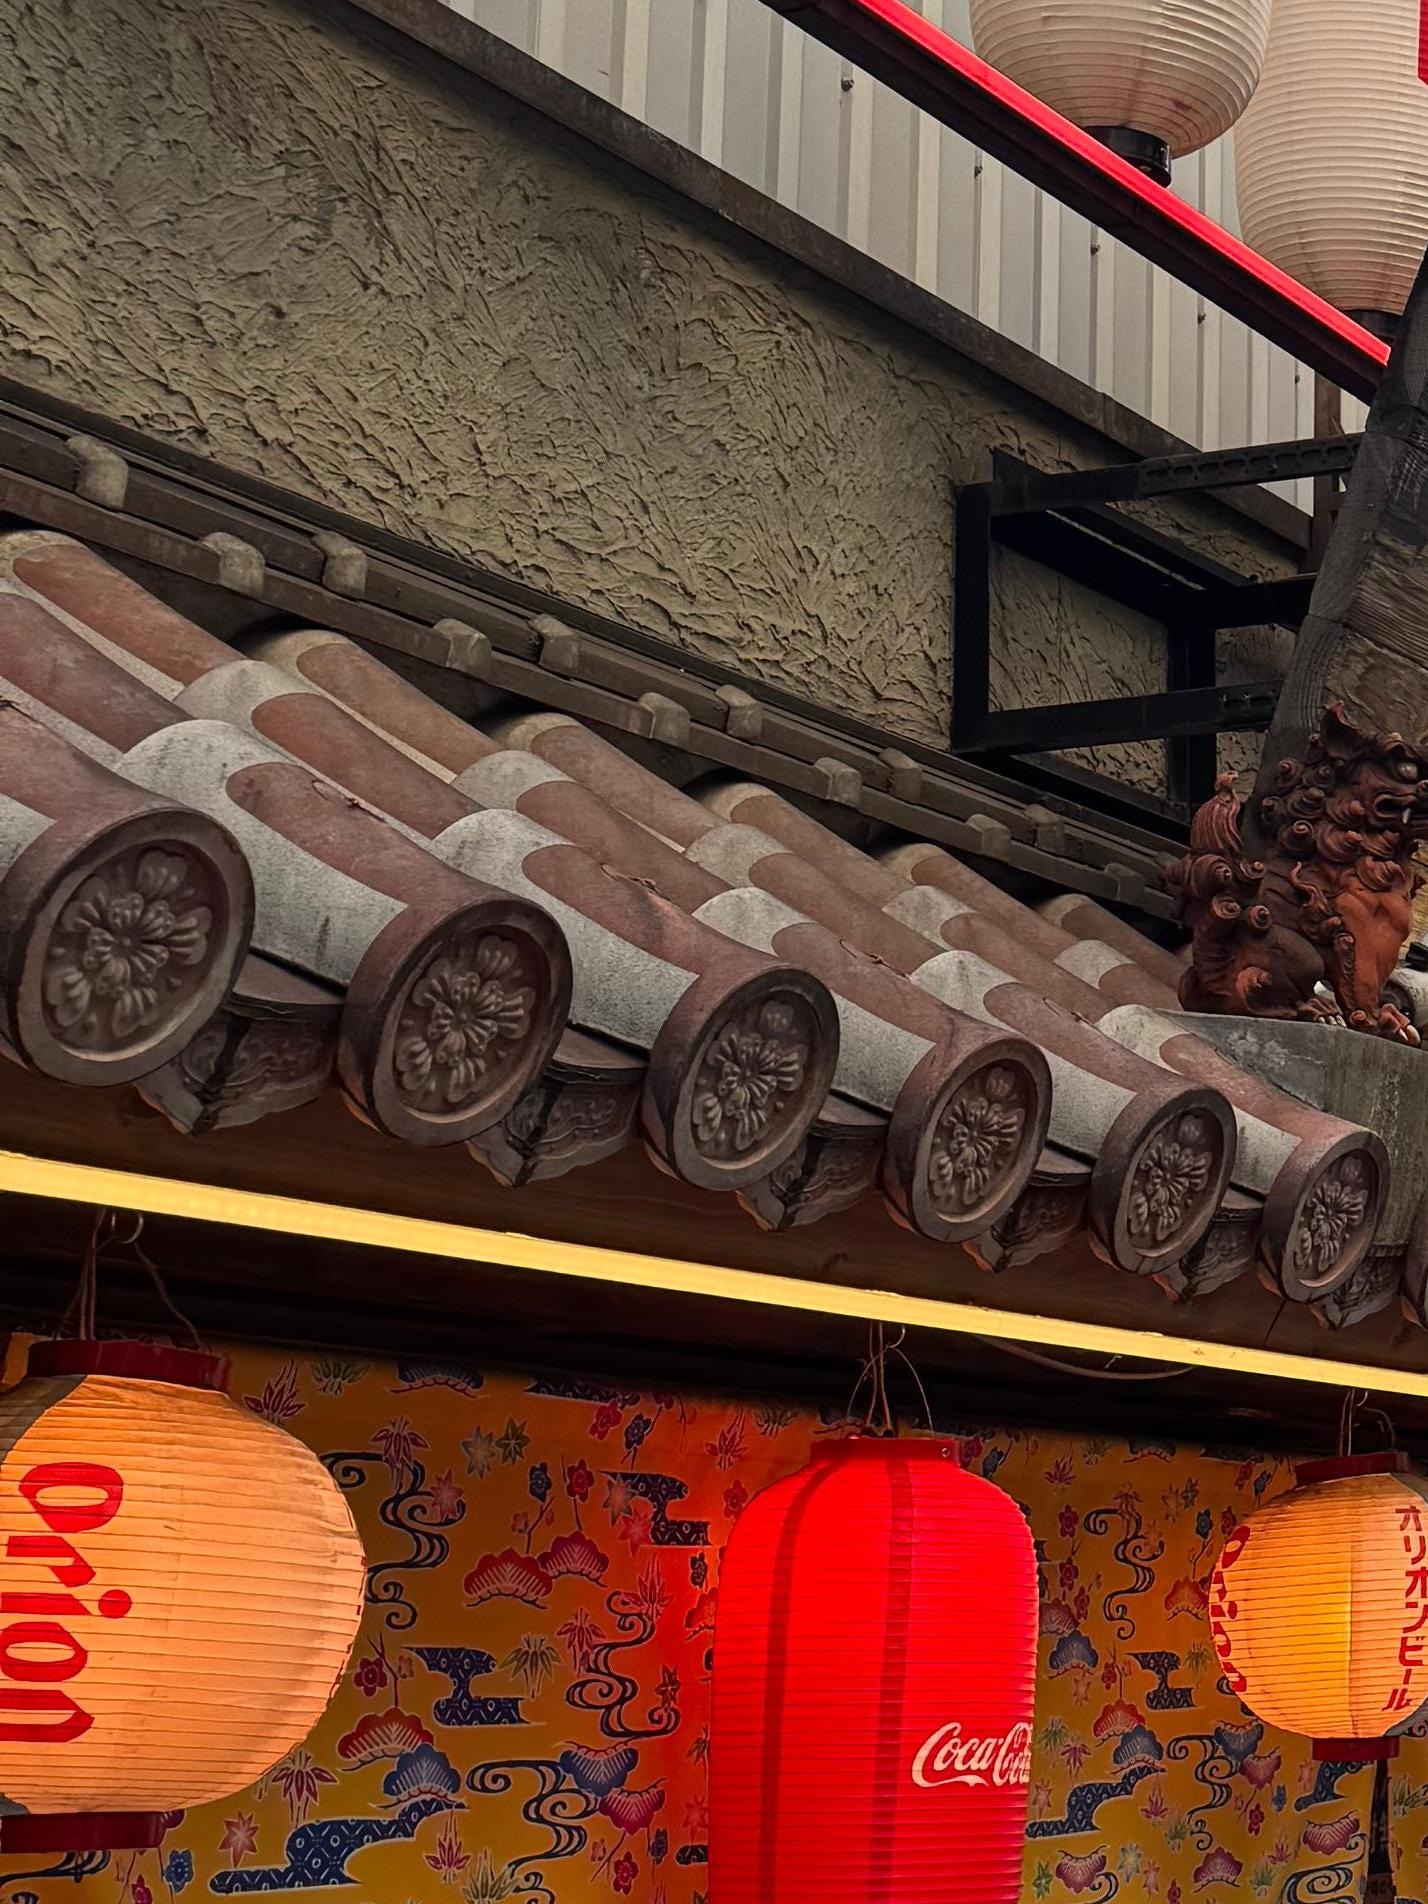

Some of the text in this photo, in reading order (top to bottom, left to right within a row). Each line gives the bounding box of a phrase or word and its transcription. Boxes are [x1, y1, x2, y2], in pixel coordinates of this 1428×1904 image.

[1381, 1505, 1427, 1713] オリオンビール
